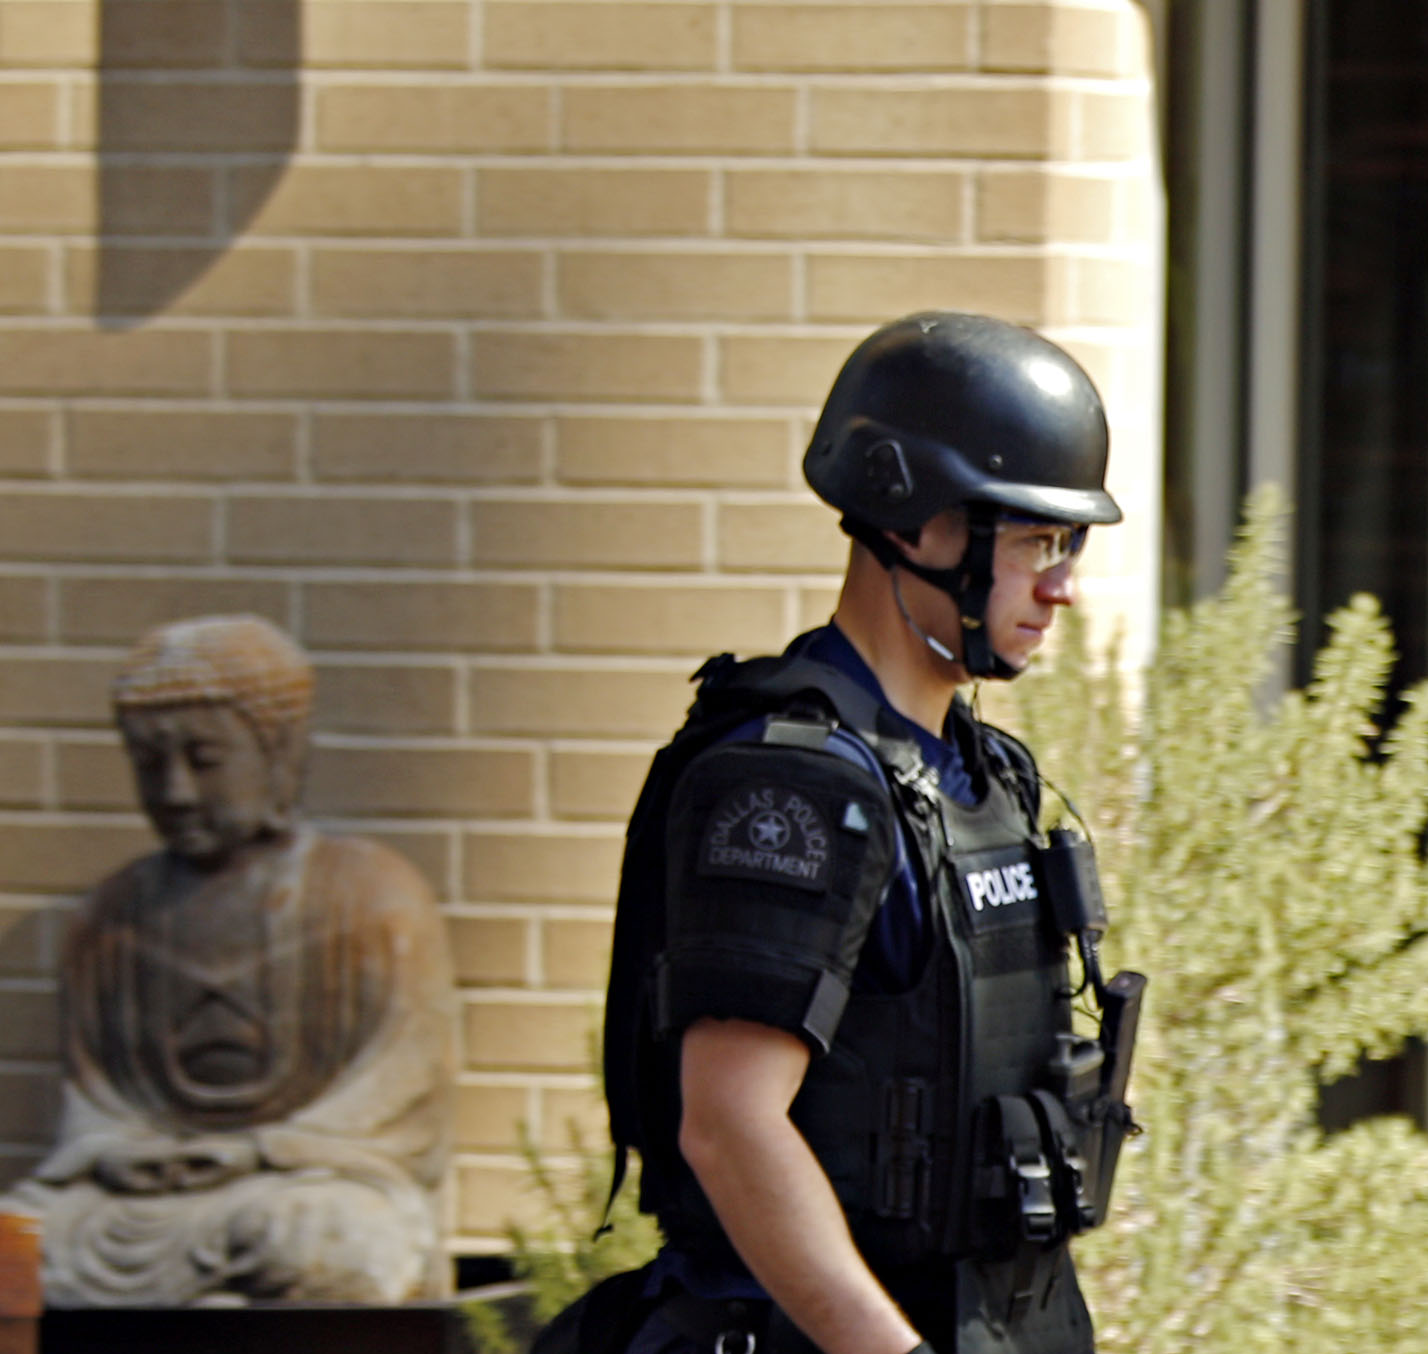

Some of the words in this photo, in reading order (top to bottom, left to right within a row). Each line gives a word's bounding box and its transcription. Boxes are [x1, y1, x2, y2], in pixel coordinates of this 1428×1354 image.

[710, 788, 774, 845] DALLAS
[785, 794, 827, 862] POLICE
[708, 846, 822, 880] DEPARTMENT
[966, 861, 1038, 912] POLICE
